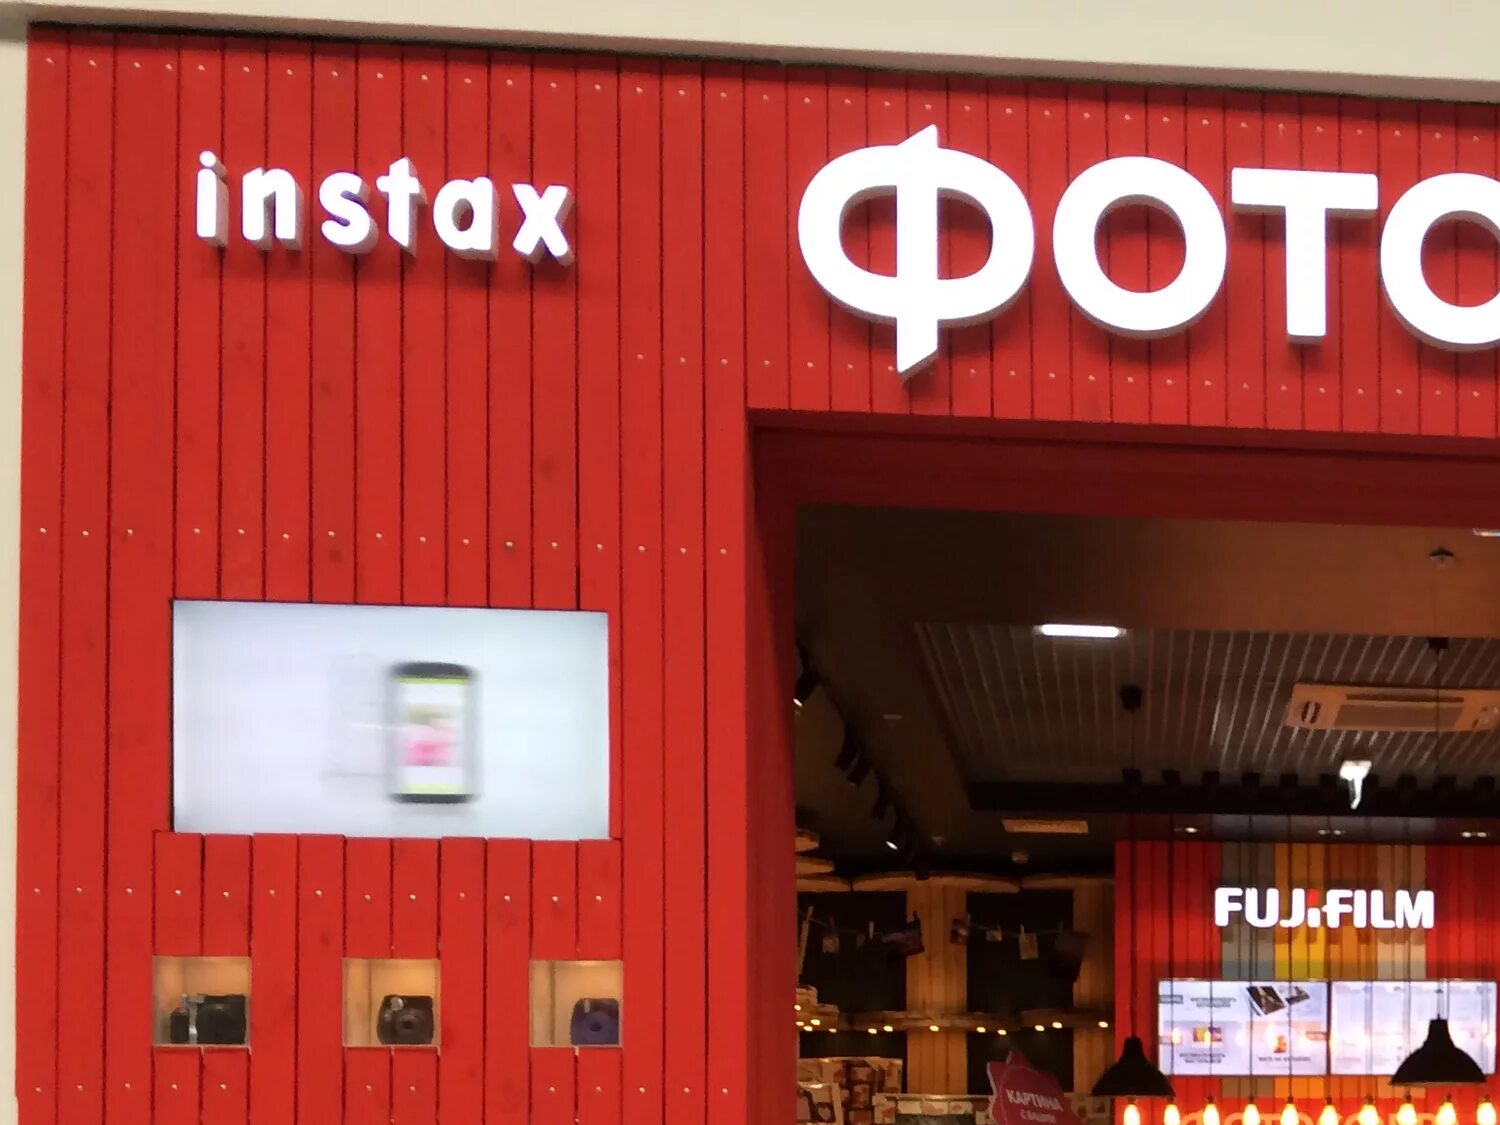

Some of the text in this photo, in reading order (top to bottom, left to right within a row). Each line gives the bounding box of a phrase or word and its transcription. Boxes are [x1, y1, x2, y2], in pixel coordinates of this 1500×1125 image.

[195, 151, 573, 265] instax
[1214, 887, 1435, 929] FUJIFILM
[1006, 1089, 1063, 1112] КАРТИНА
